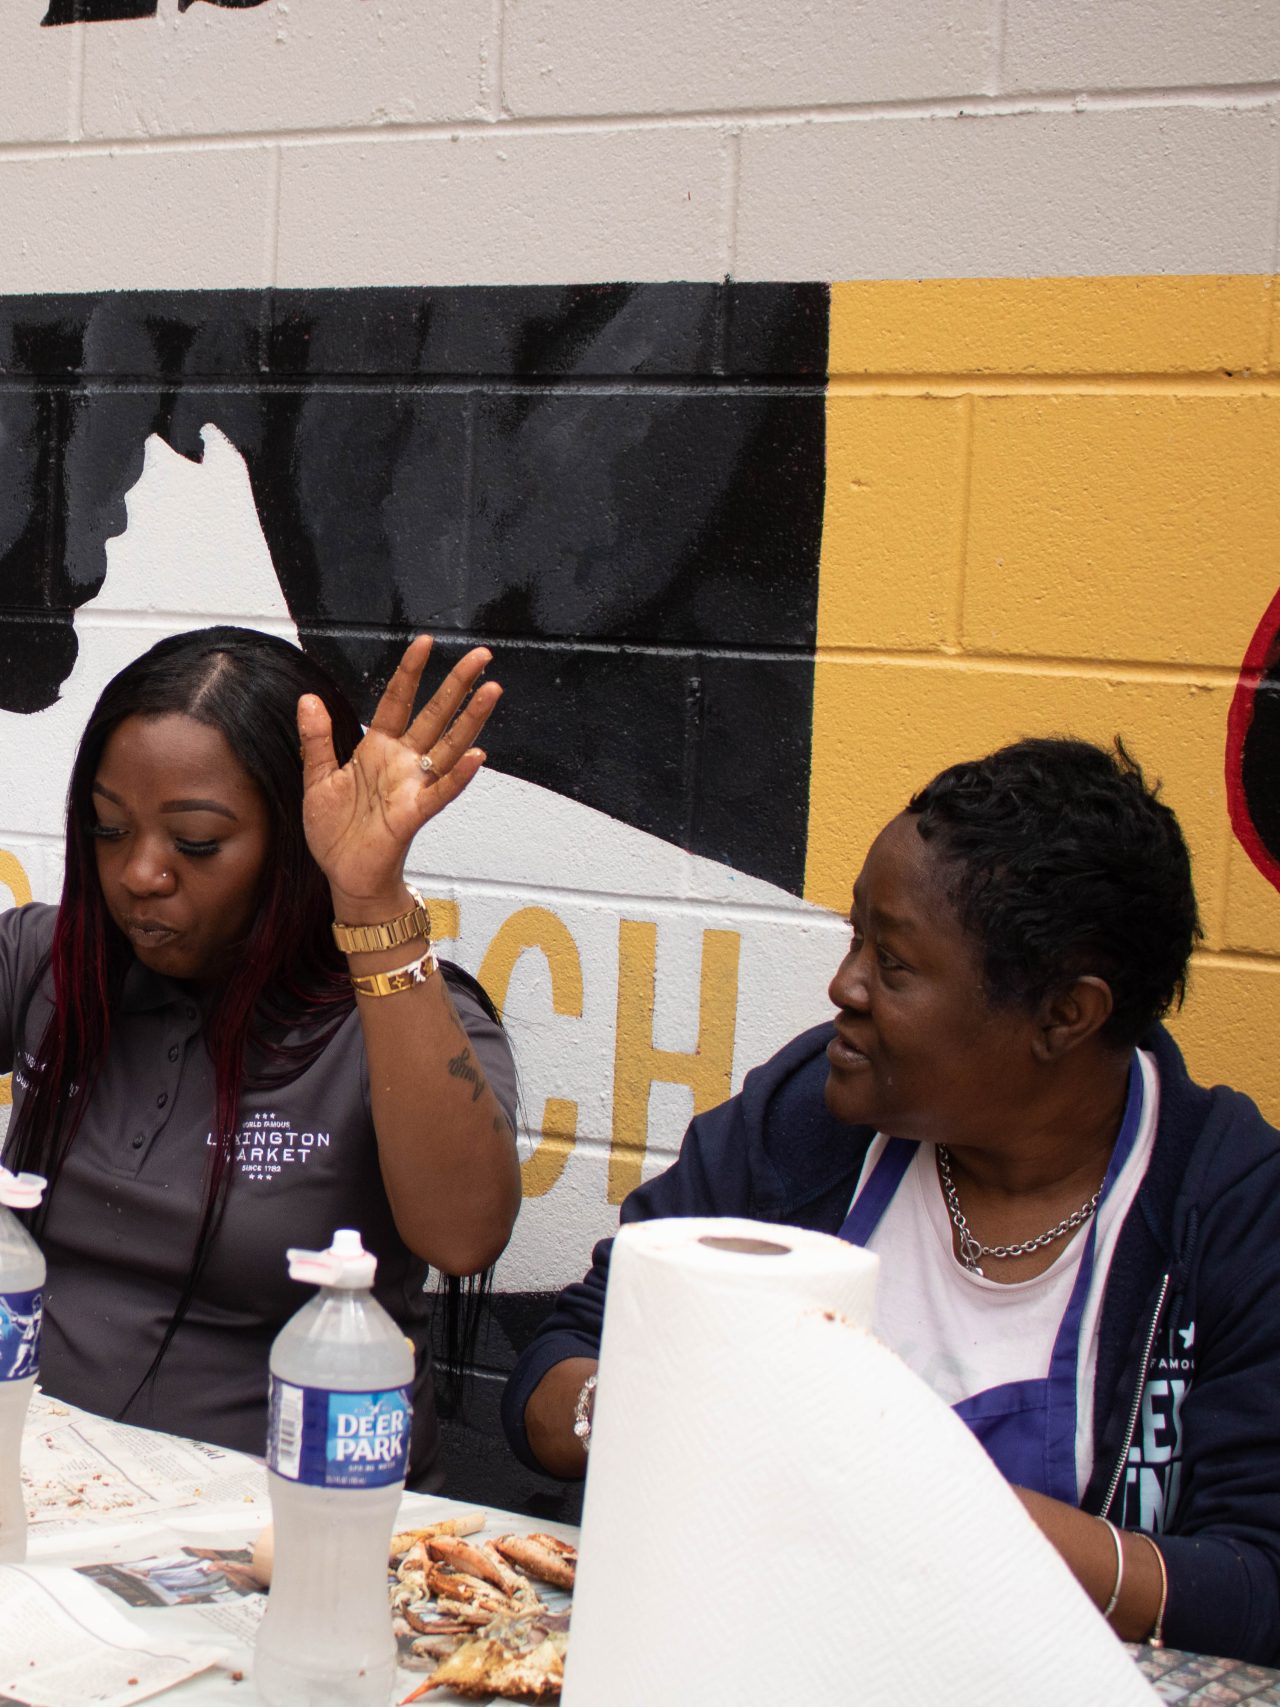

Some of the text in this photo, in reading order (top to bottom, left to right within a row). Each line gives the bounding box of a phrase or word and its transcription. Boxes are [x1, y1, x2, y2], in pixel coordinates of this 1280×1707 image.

[263, 1120, 290, 1128] FAMOUS
[224, 1147, 311, 1163] ARKET
[241, 1164, 262, 1172] SINCE
[336, 1409, 404, 1437] DEER
[335, 1432, 403, 1462] PARK
